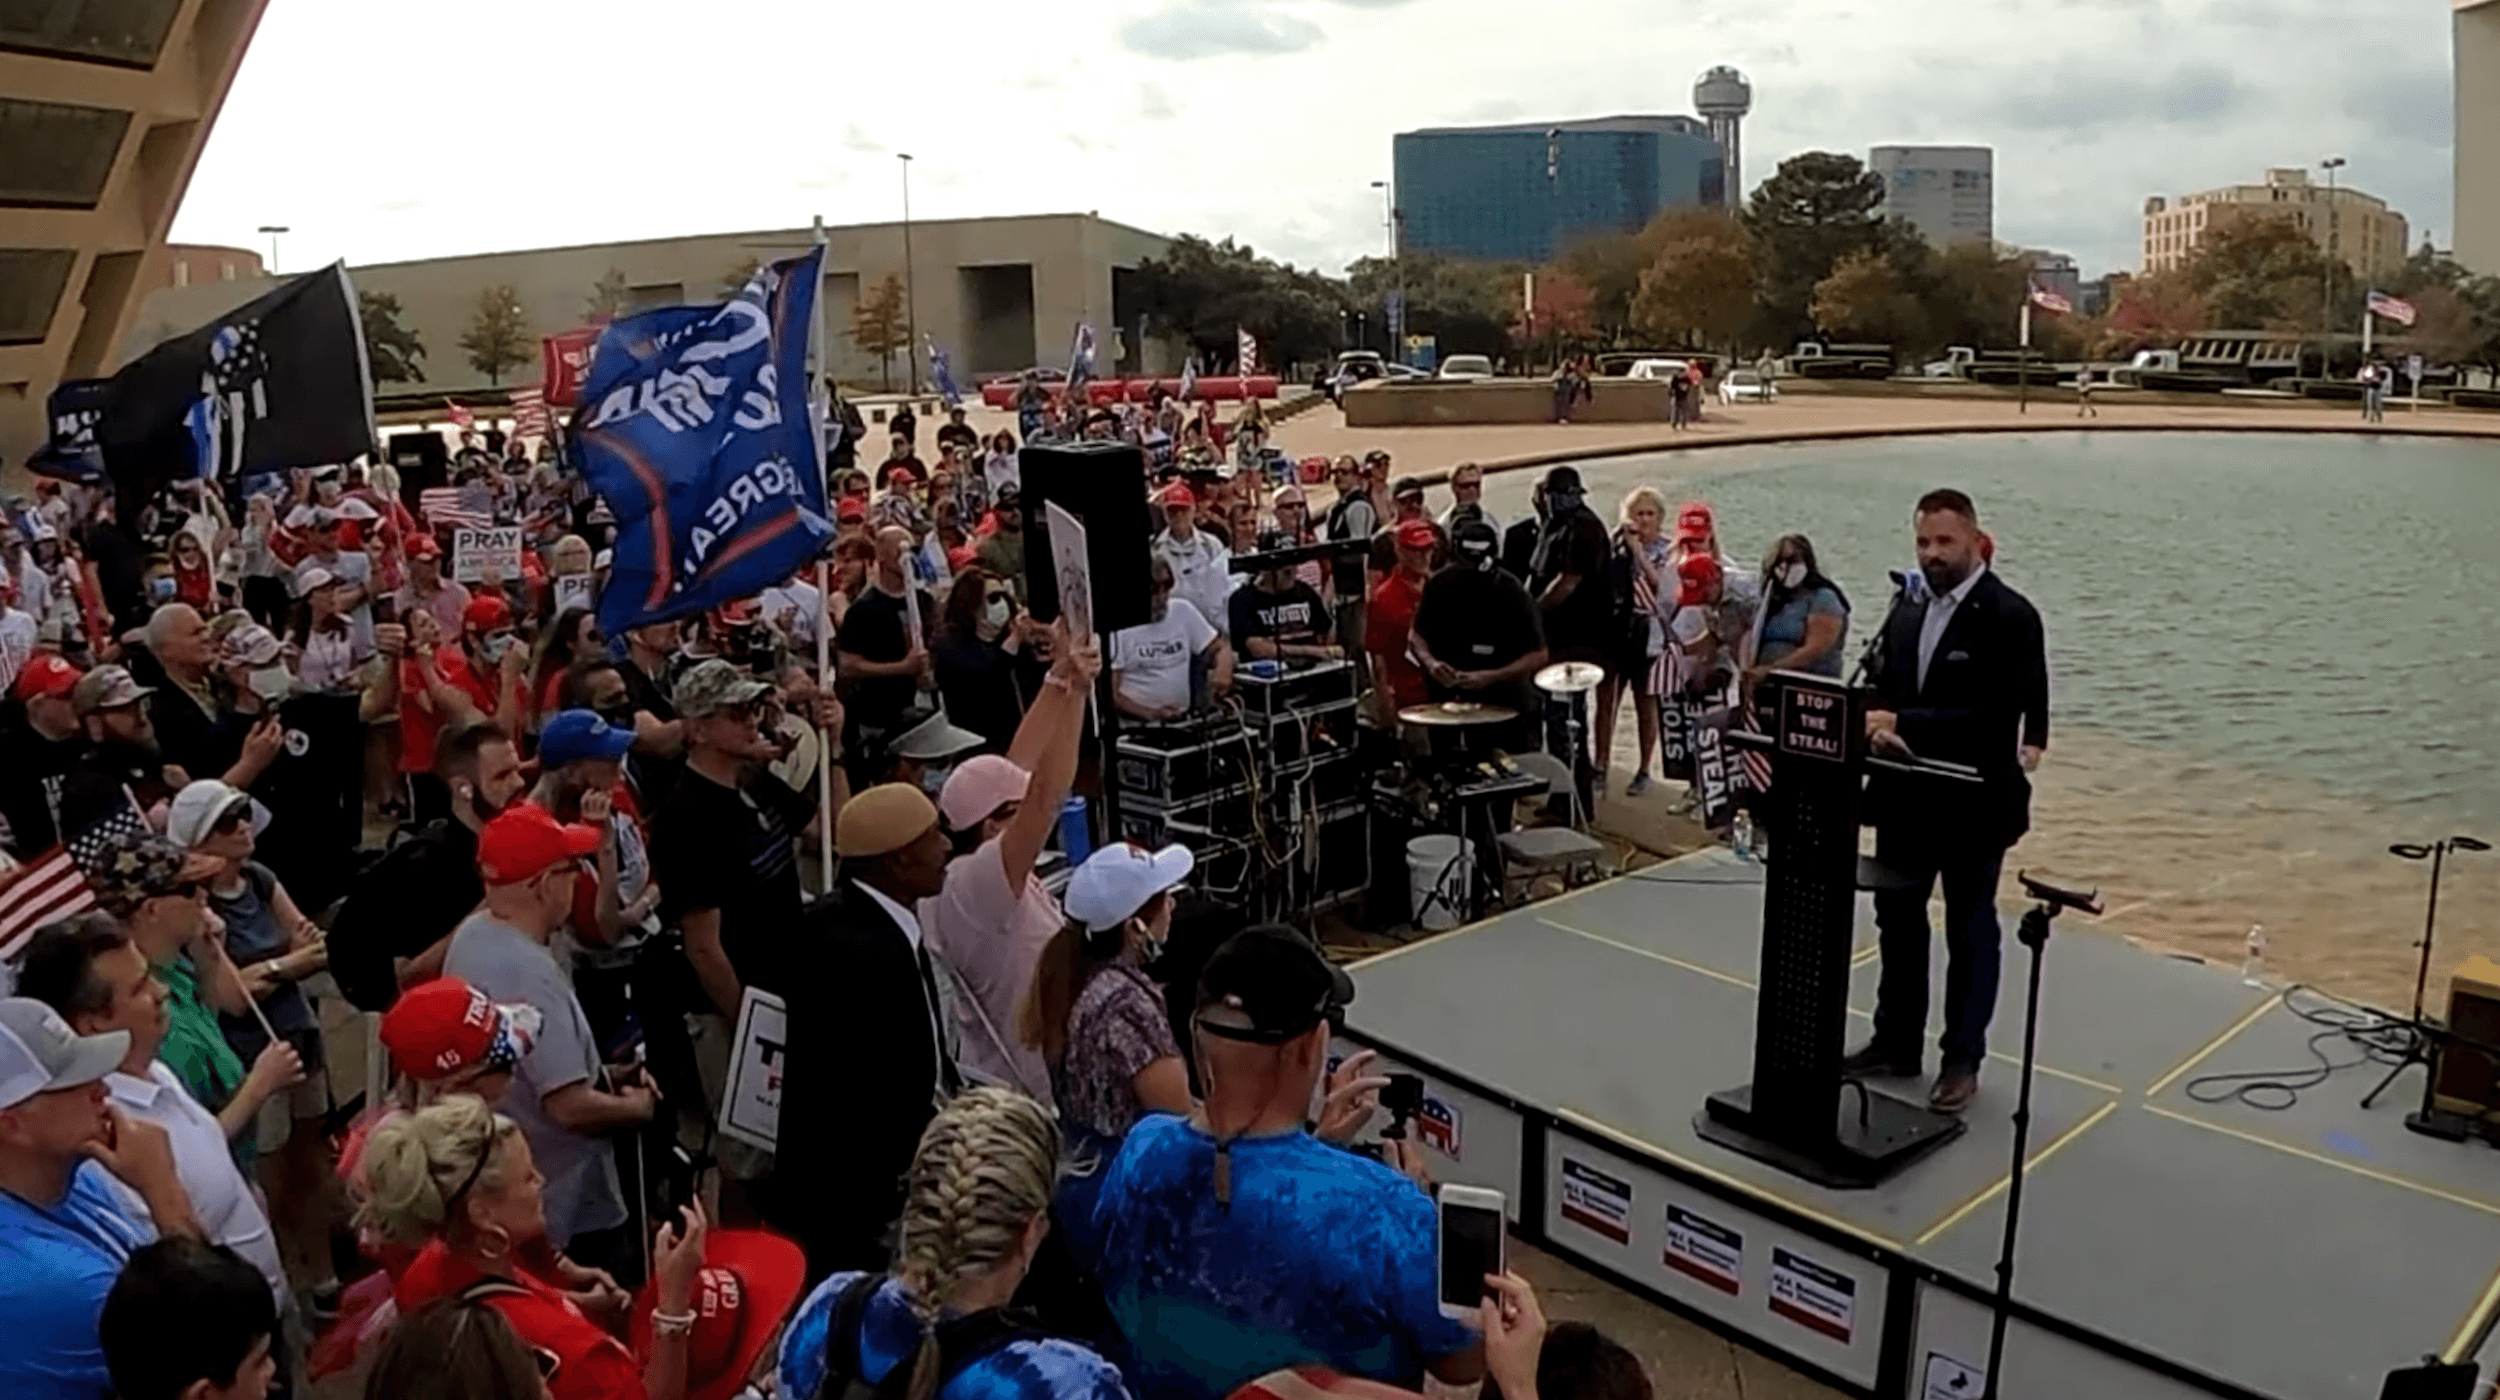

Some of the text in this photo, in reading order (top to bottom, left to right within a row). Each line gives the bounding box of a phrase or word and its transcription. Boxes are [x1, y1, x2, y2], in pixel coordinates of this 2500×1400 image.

[459, 530, 518, 549] PRAY
[1796, 692, 1834, 711] STOP
[1800, 713, 1828, 731] THE
[1788, 731, 1838, 754] STEAL!
[1698, 727, 1728, 818] STEAL
[436, 1049, 461, 1070] 45
